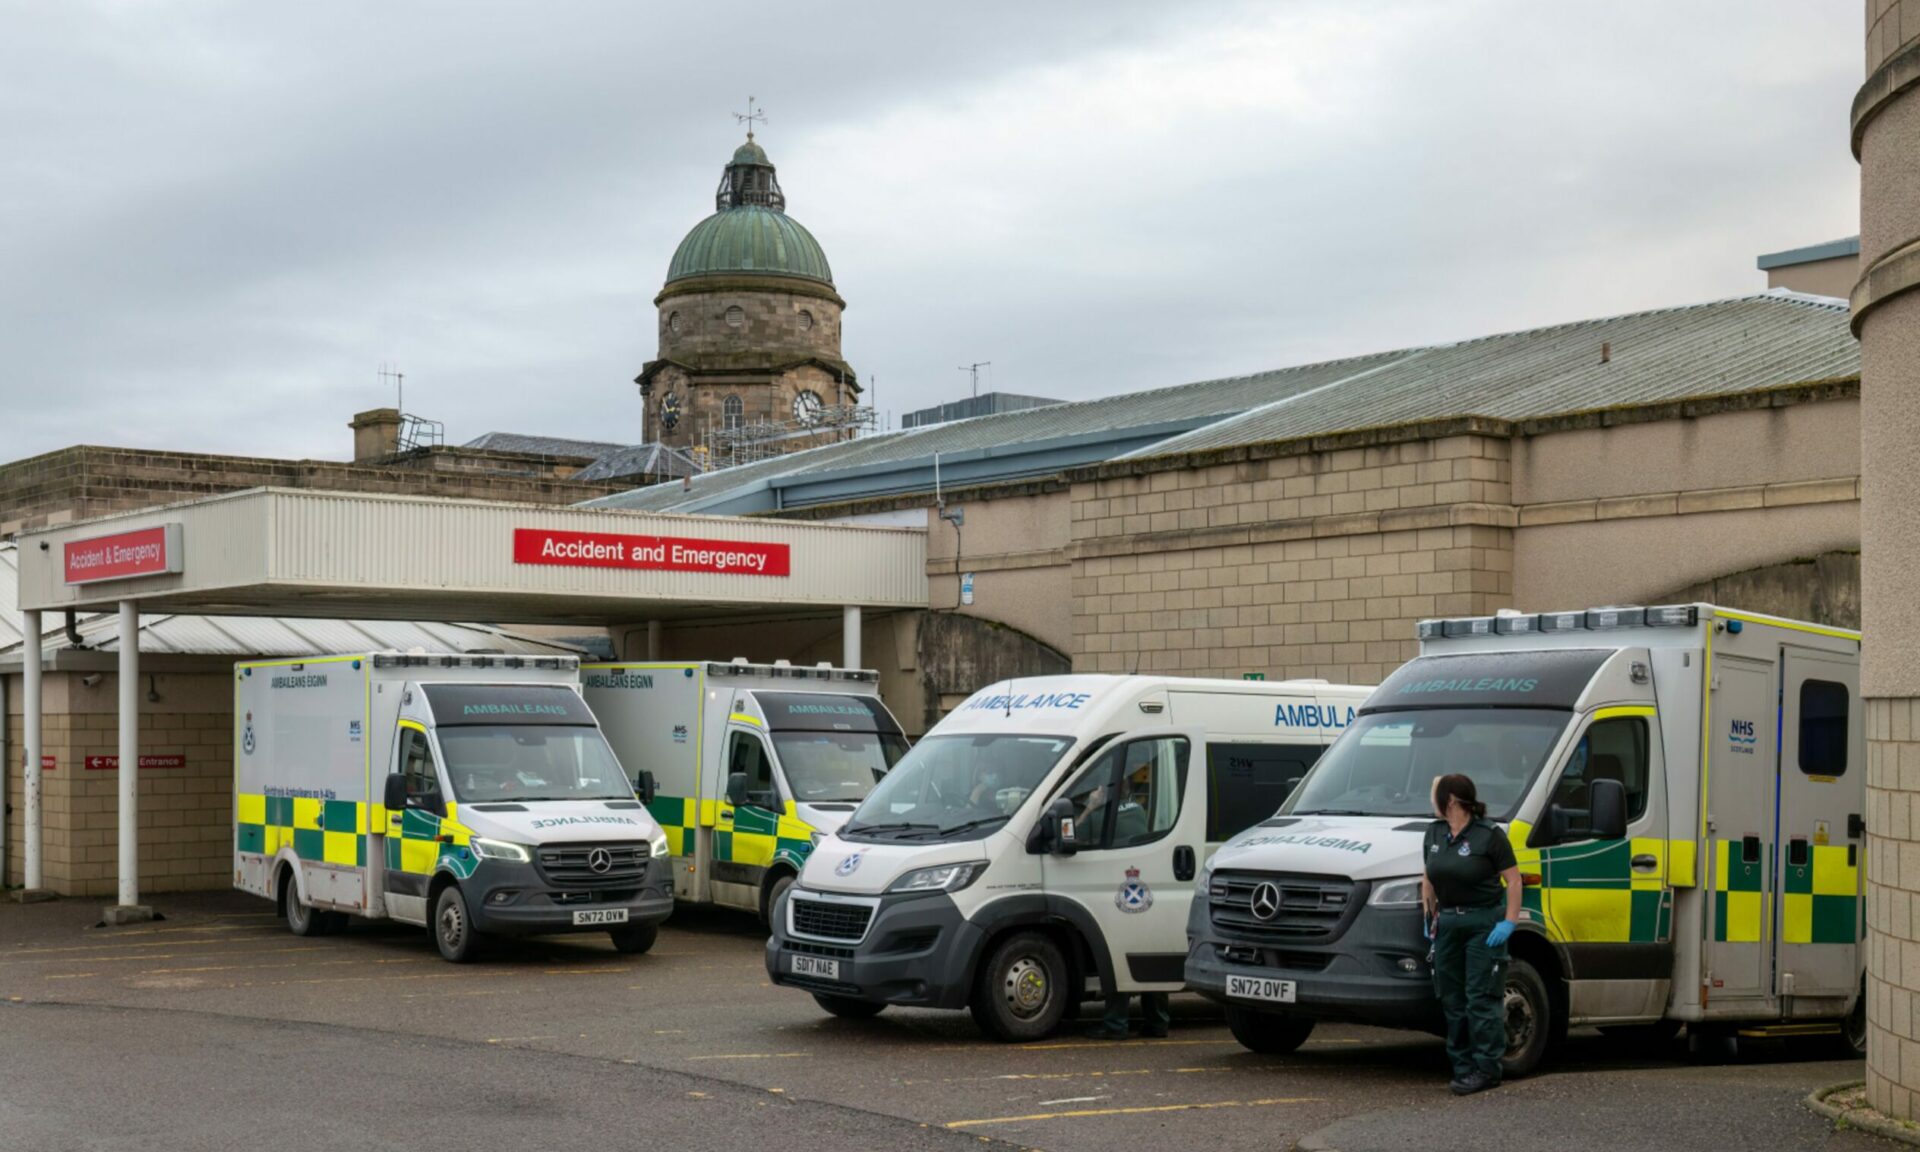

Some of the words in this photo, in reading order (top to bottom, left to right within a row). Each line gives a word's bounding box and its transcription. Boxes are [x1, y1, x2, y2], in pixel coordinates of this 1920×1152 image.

[70, 548, 104, 569] Accident
[106, 546, 112, 565] &
[114, 543, 160, 565] Emergency
[542, 538, 624, 560] Accident
[632, 545, 664, 562] and
[672, 546, 766, 571] Emergency
[1395, 678, 1539, 695] AMBAILEANS
[464, 704, 567, 715] AMBAILEANS
[963, 693, 1091, 710] AMBULANCE
[788, 705, 875, 717] AMBAILEANS
[1275, 704, 1356, 728] AMBULA
[674, 725, 687, 734] NHS
[1731, 719, 1754, 736] NHS
[140, 756, 180, 766] Entrance
[578, 912, 603, 922] SN72
[816, 960, 833, 975] NAE
[1231, 978, 1261, 995] SN72
[1264, 981, 1289, 998] OVF
